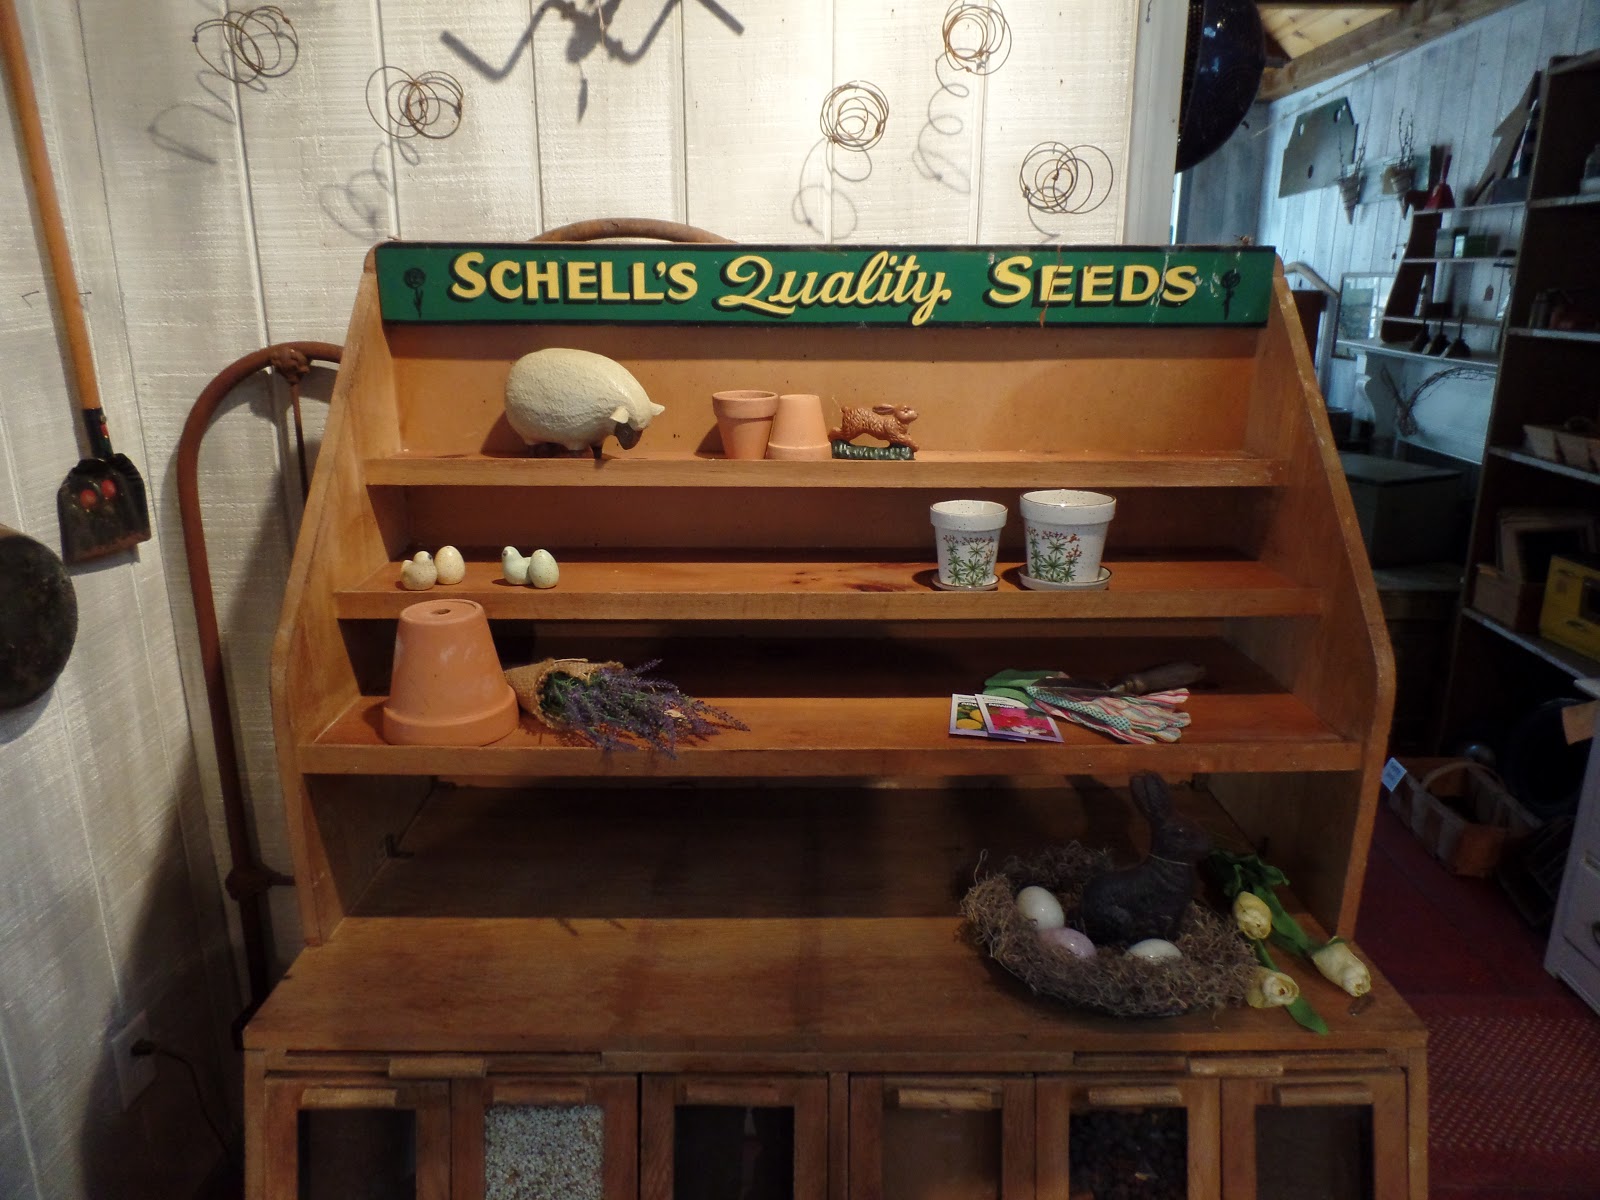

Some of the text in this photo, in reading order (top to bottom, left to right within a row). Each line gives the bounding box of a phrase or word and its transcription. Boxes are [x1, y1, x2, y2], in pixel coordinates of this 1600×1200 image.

[450, 250, 1198, 326] SCHELL'S Quality SEEDS
